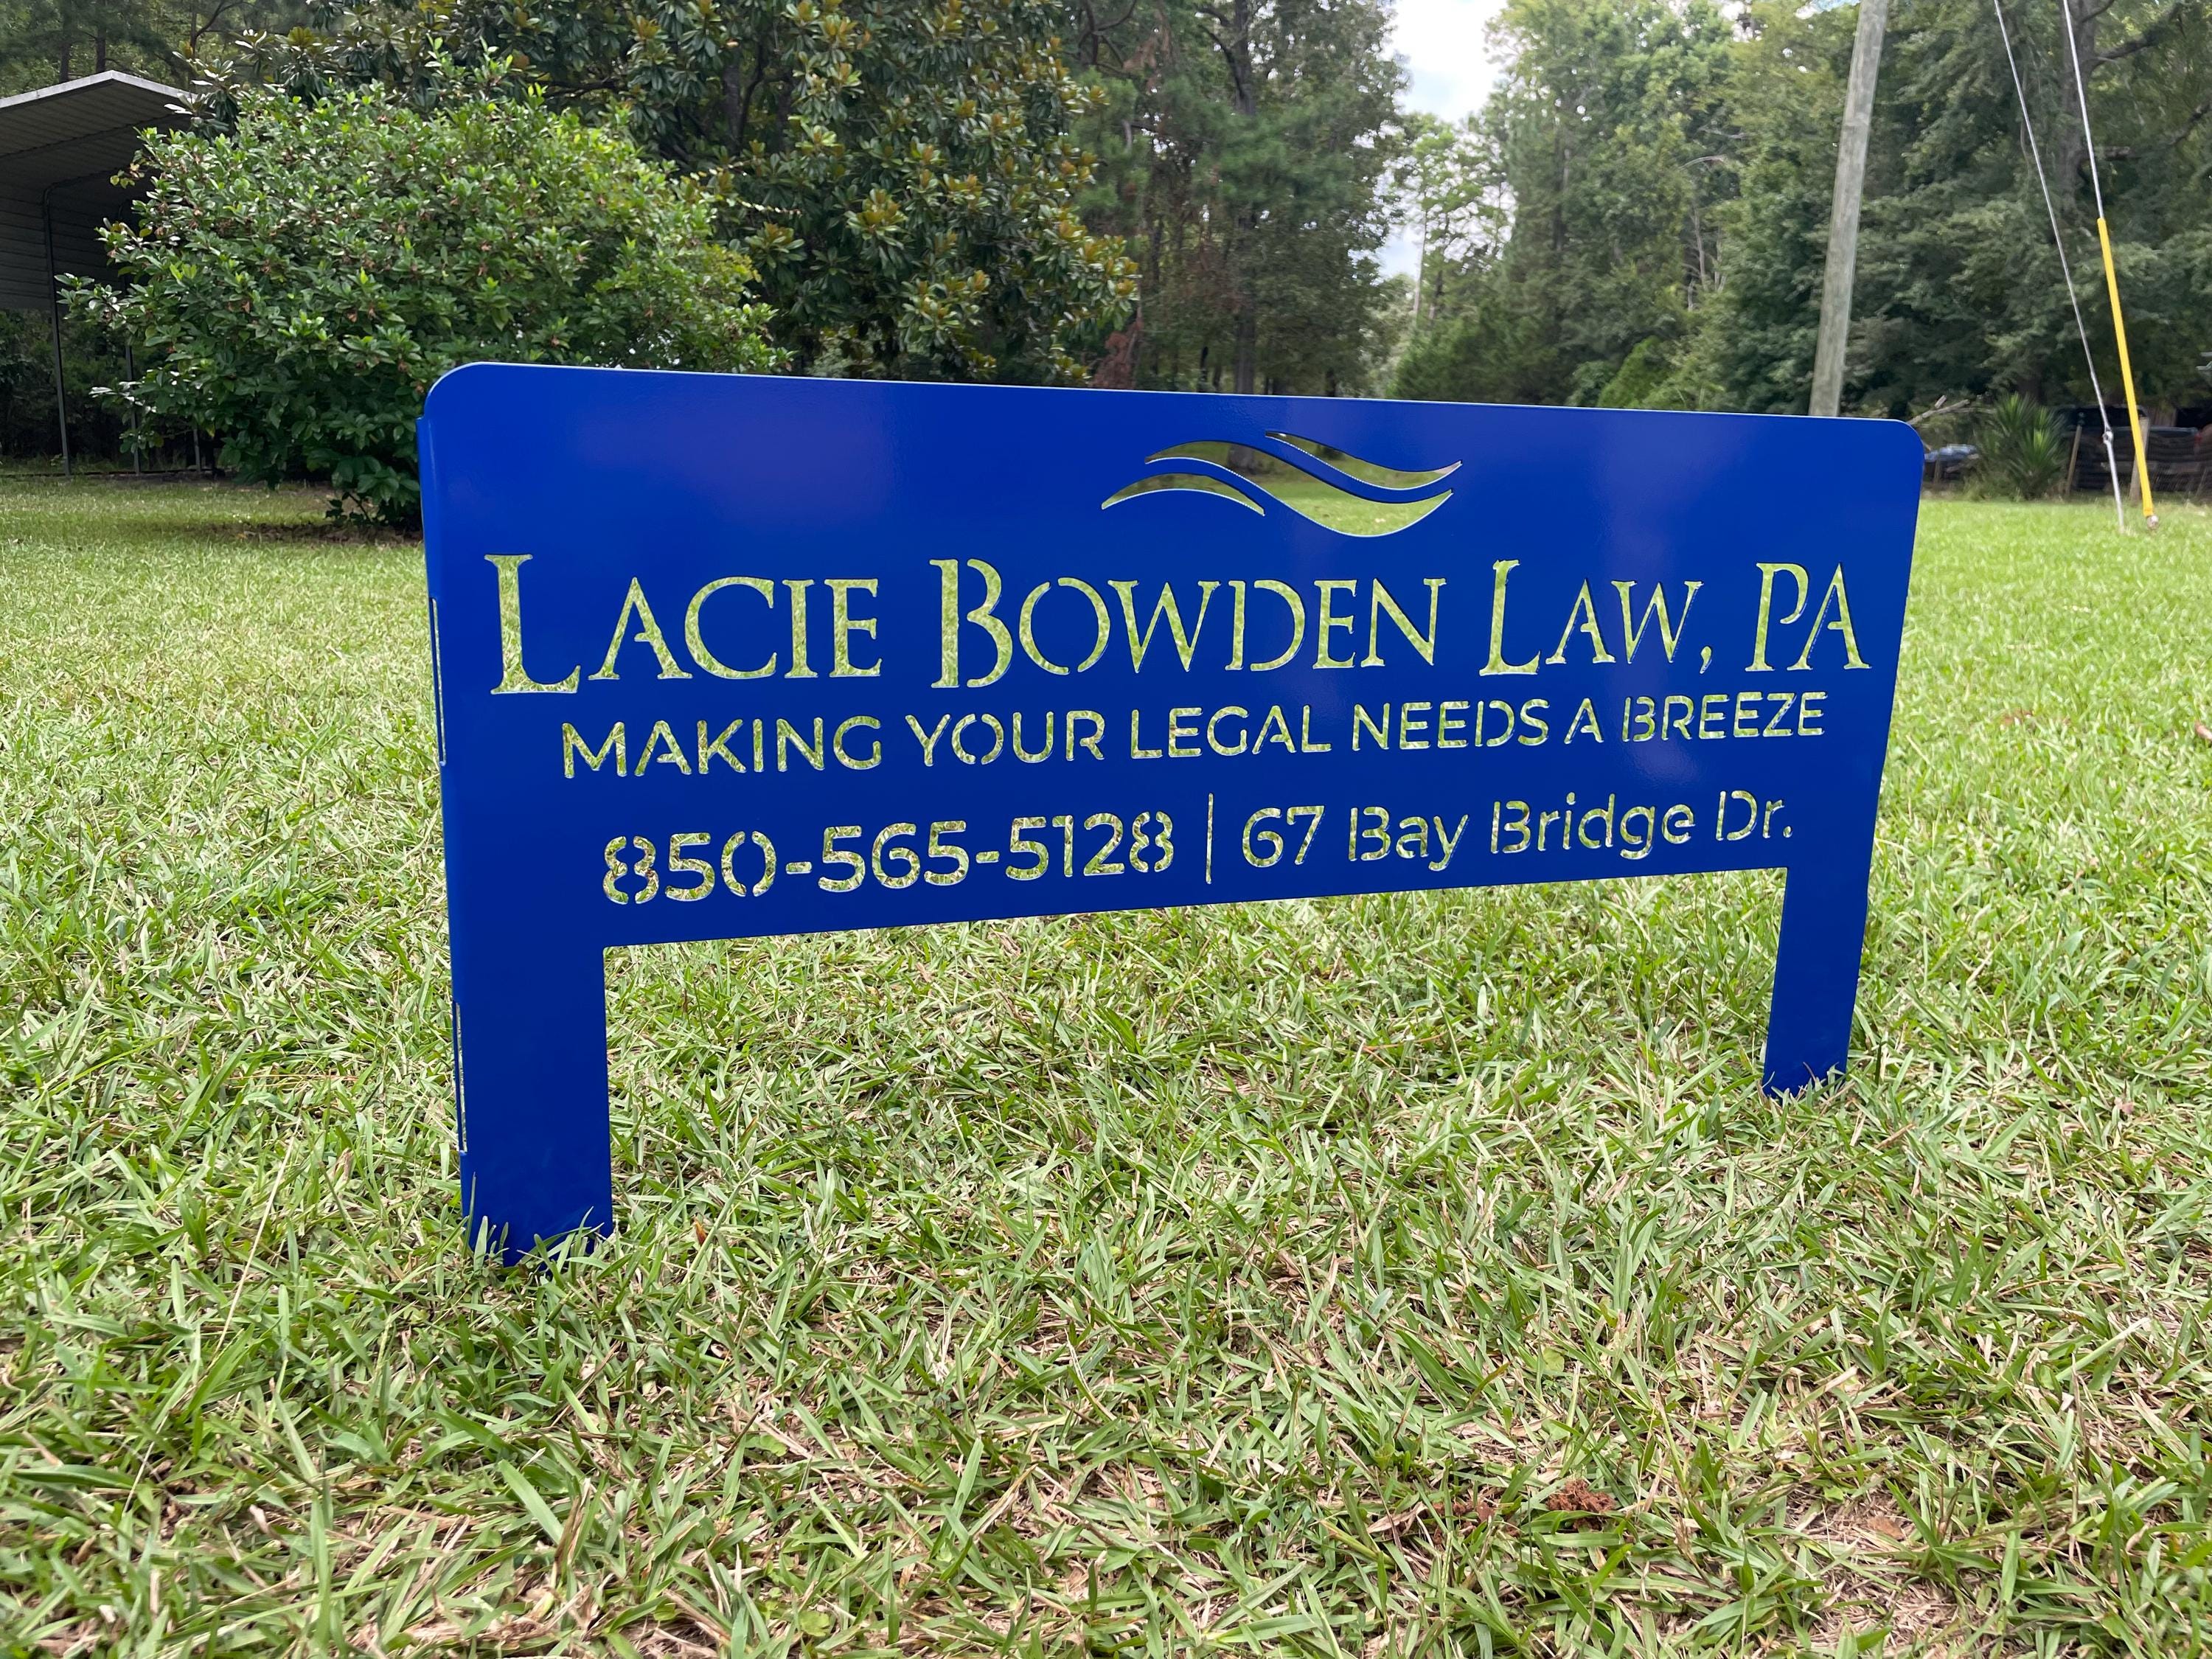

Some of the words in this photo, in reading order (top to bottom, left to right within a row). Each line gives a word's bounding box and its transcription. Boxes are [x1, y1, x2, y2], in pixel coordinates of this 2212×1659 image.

[485, 554, 882, 694] LACIE
[930, 559, 1446, 687] BOWDEN
[1746, 563, 1869, 671] PA
[562, 715, 881, 778] MAKING
[905, 710, 1105, 765] YOUR
[1131, 705, 1332, 757] LEGAL
[1352, 699, 1548, 751] NEEDS
[1565, 698, 1602, 743] A
[1622, 692, 1826, 741] BREEZE
[603, 811, 1174, 904] 850-565-5128
[1242, 805, 1324, 866] 67
[1349, 807, 1468, 870] Bay
[1491, 793, 1694, 859] Bridge
[1717, 790, 1791, 840] Dr.
